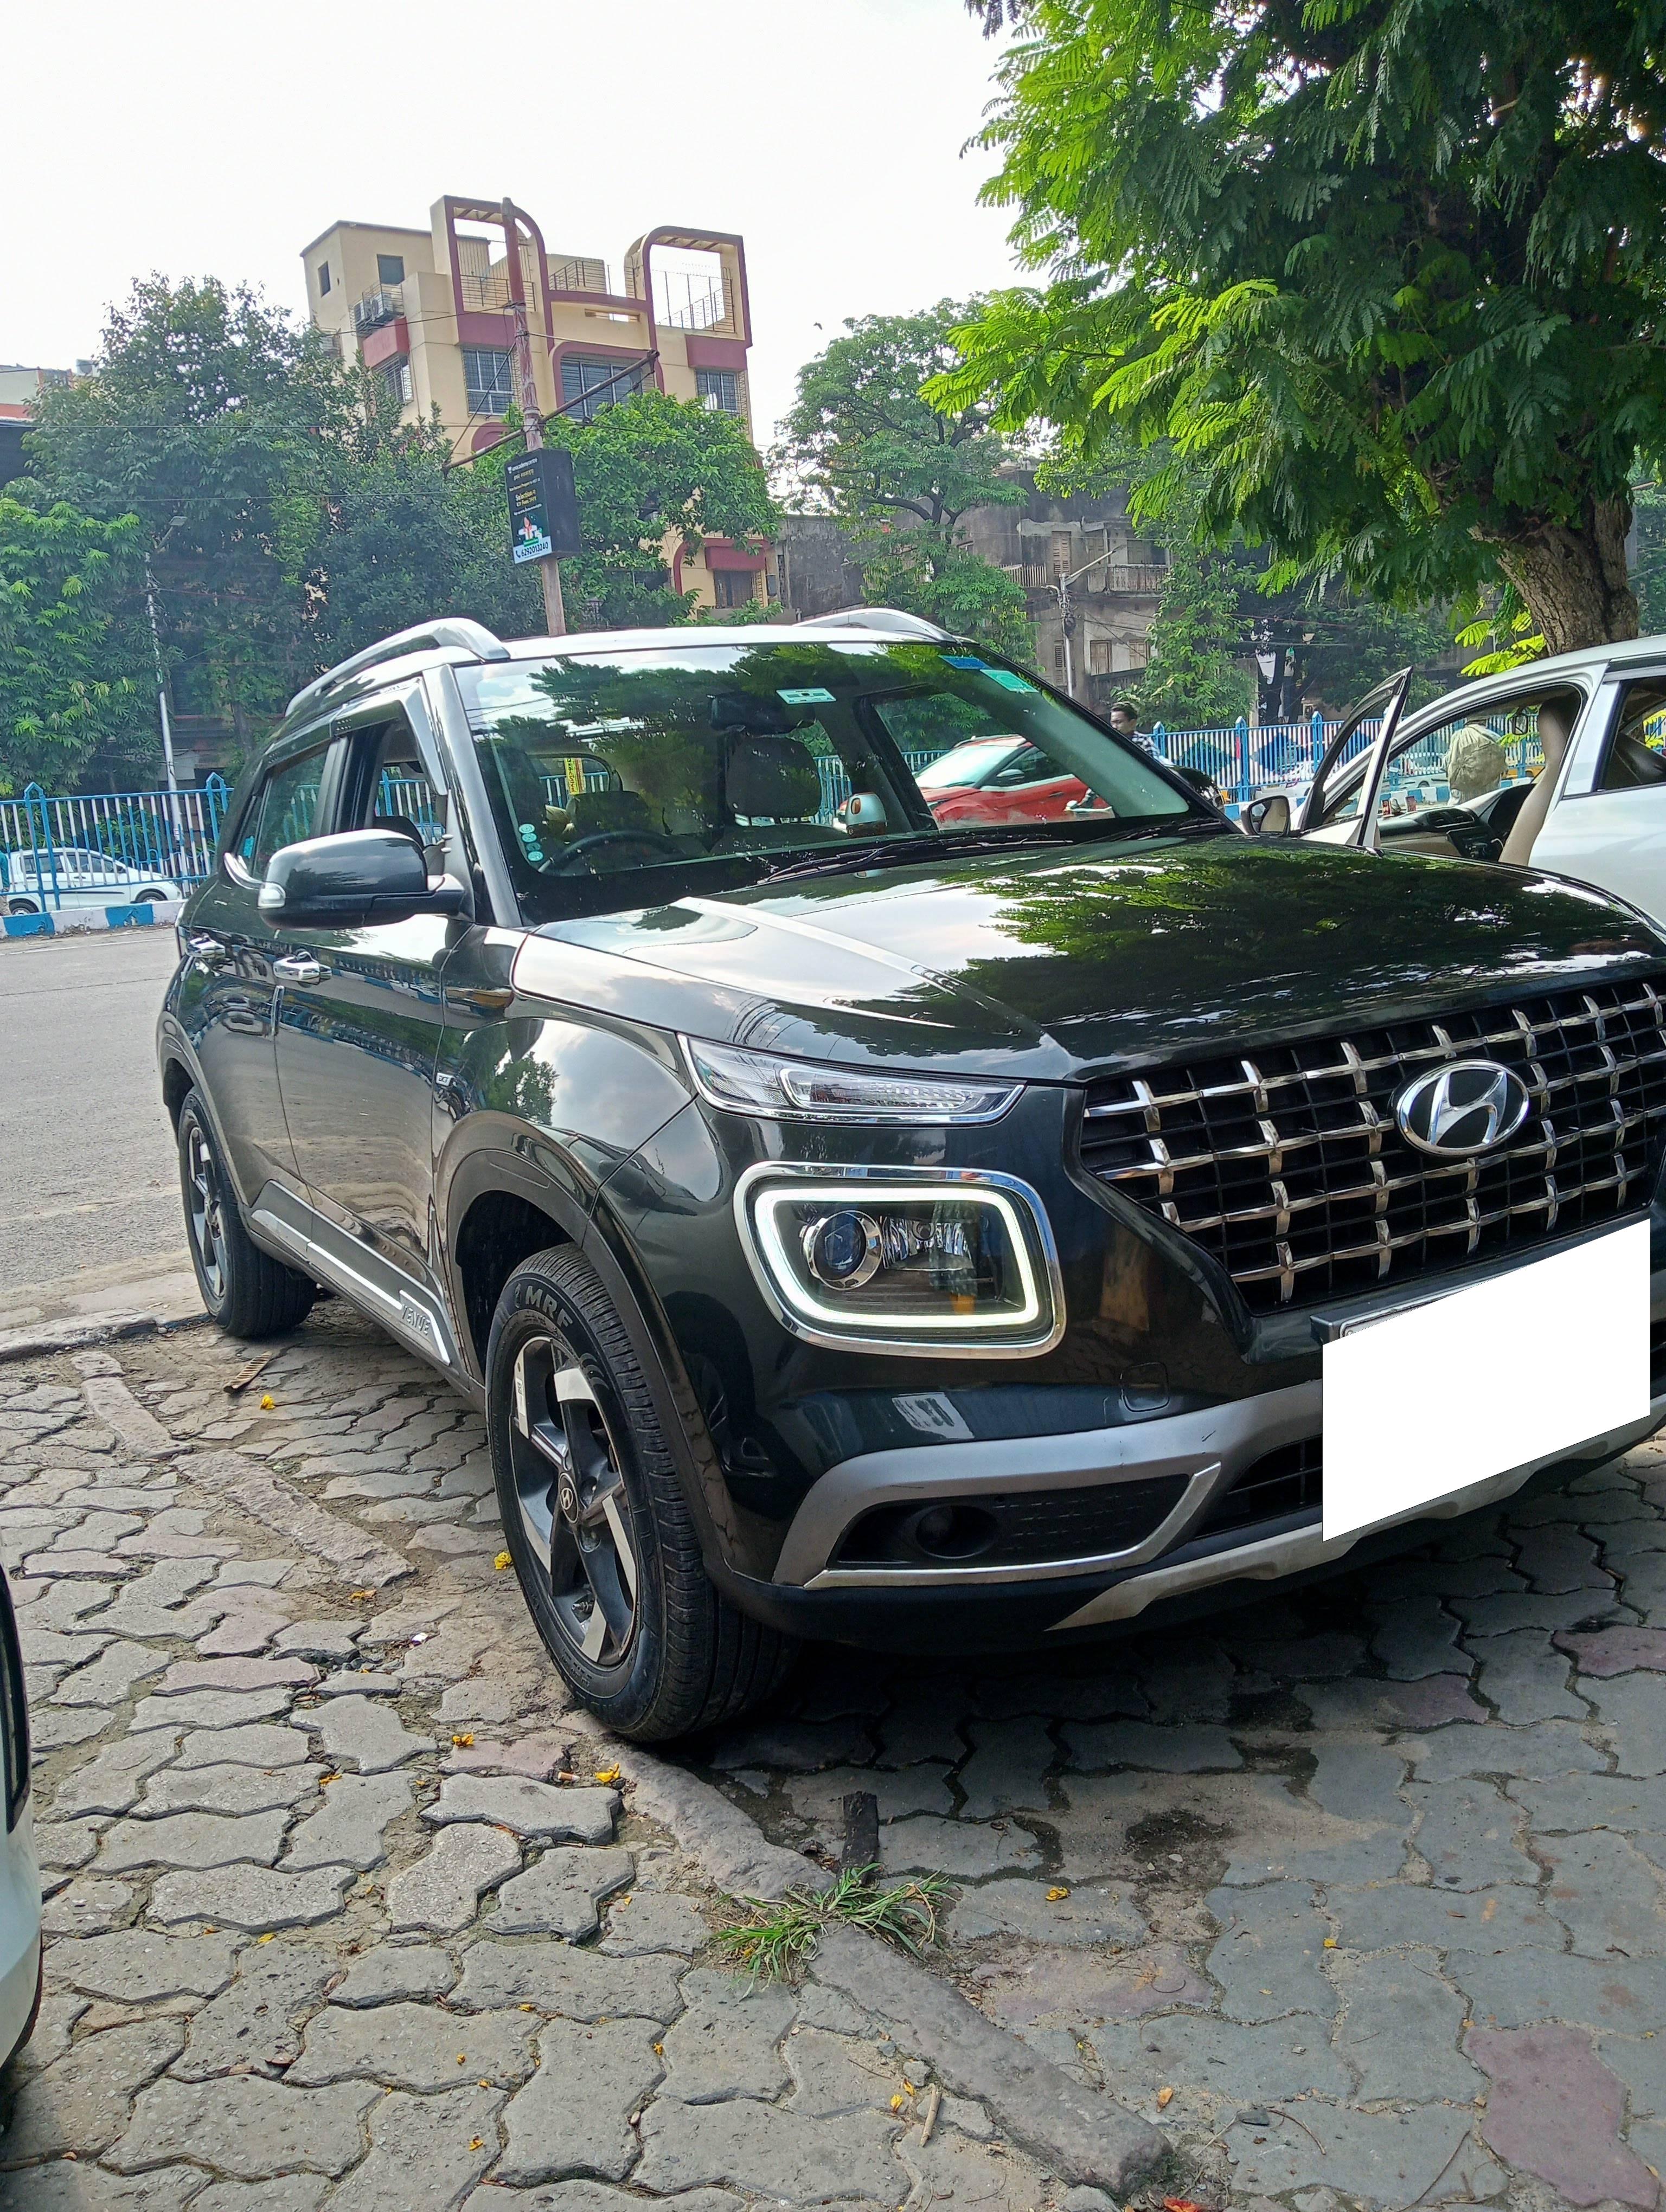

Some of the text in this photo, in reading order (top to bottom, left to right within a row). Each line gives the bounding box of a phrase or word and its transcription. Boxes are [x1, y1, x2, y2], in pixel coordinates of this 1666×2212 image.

[521, 542, 548, 557] 6292013240
[402, 1303, 431, 1336] VENUE
[525, 1285, 573, 1328] MRF
